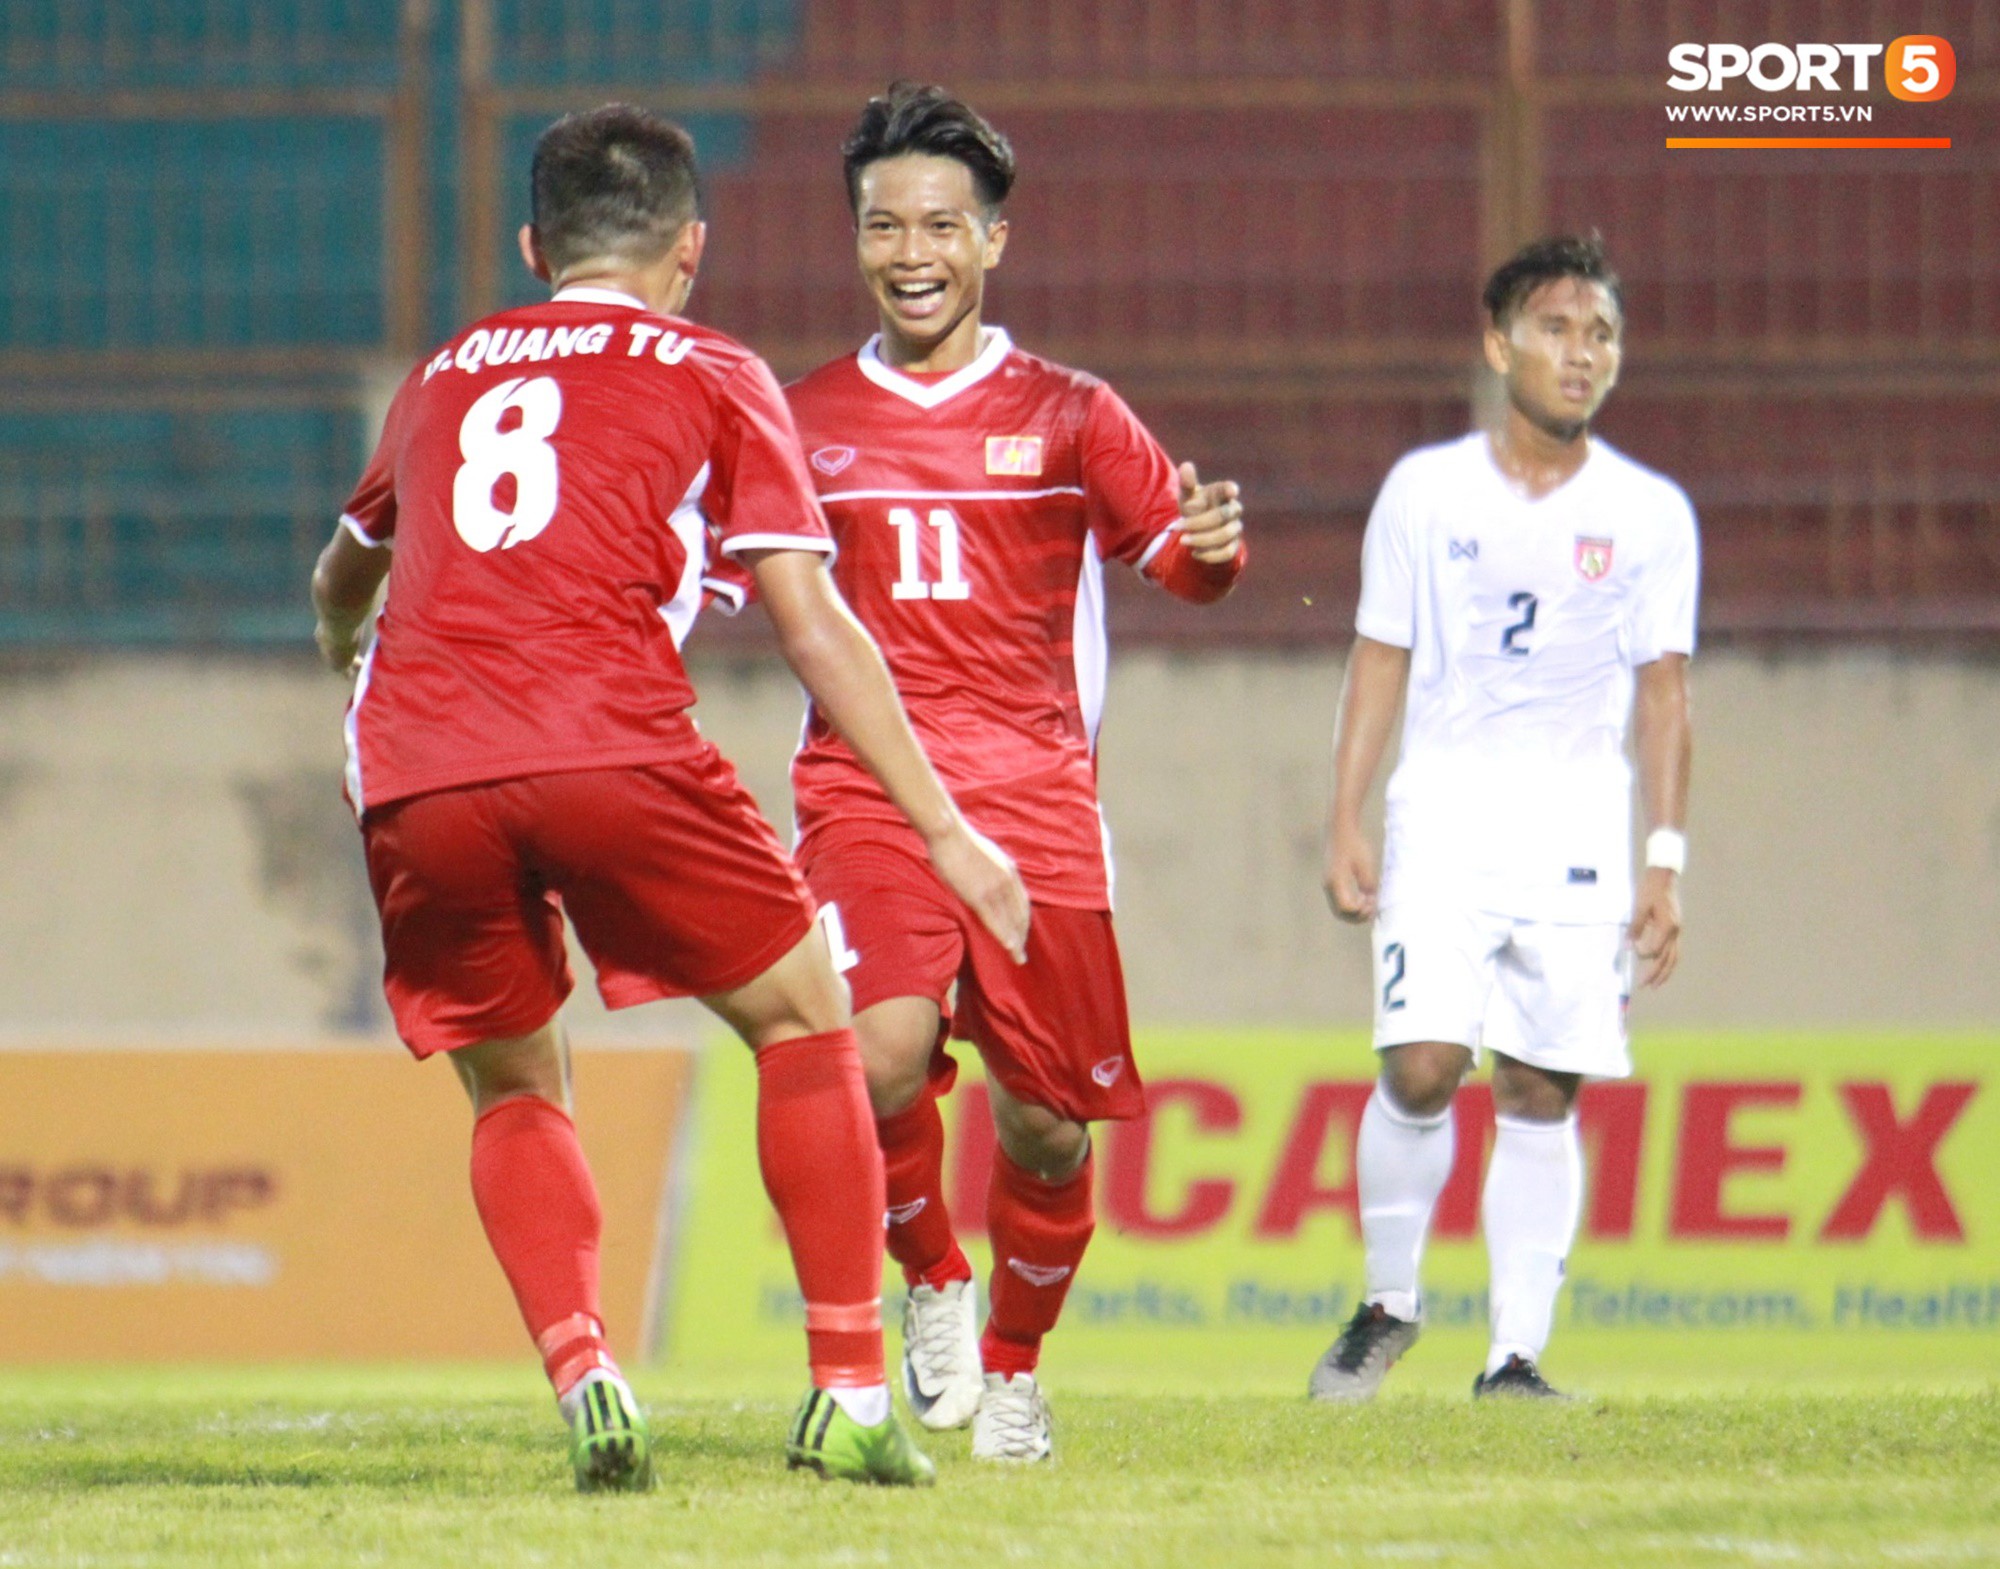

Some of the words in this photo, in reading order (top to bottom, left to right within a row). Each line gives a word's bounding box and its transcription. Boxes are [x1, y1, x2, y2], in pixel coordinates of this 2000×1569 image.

[628, 322, 695, 366] TU
[453, 376, 562, 553] 8
[888, 508, 970, 600] 11
[1501, 592, 1537, 655] 2
[1383, 942, 1405, 1012] 2
[768, 1078, 1980, 1242] CAMEX
